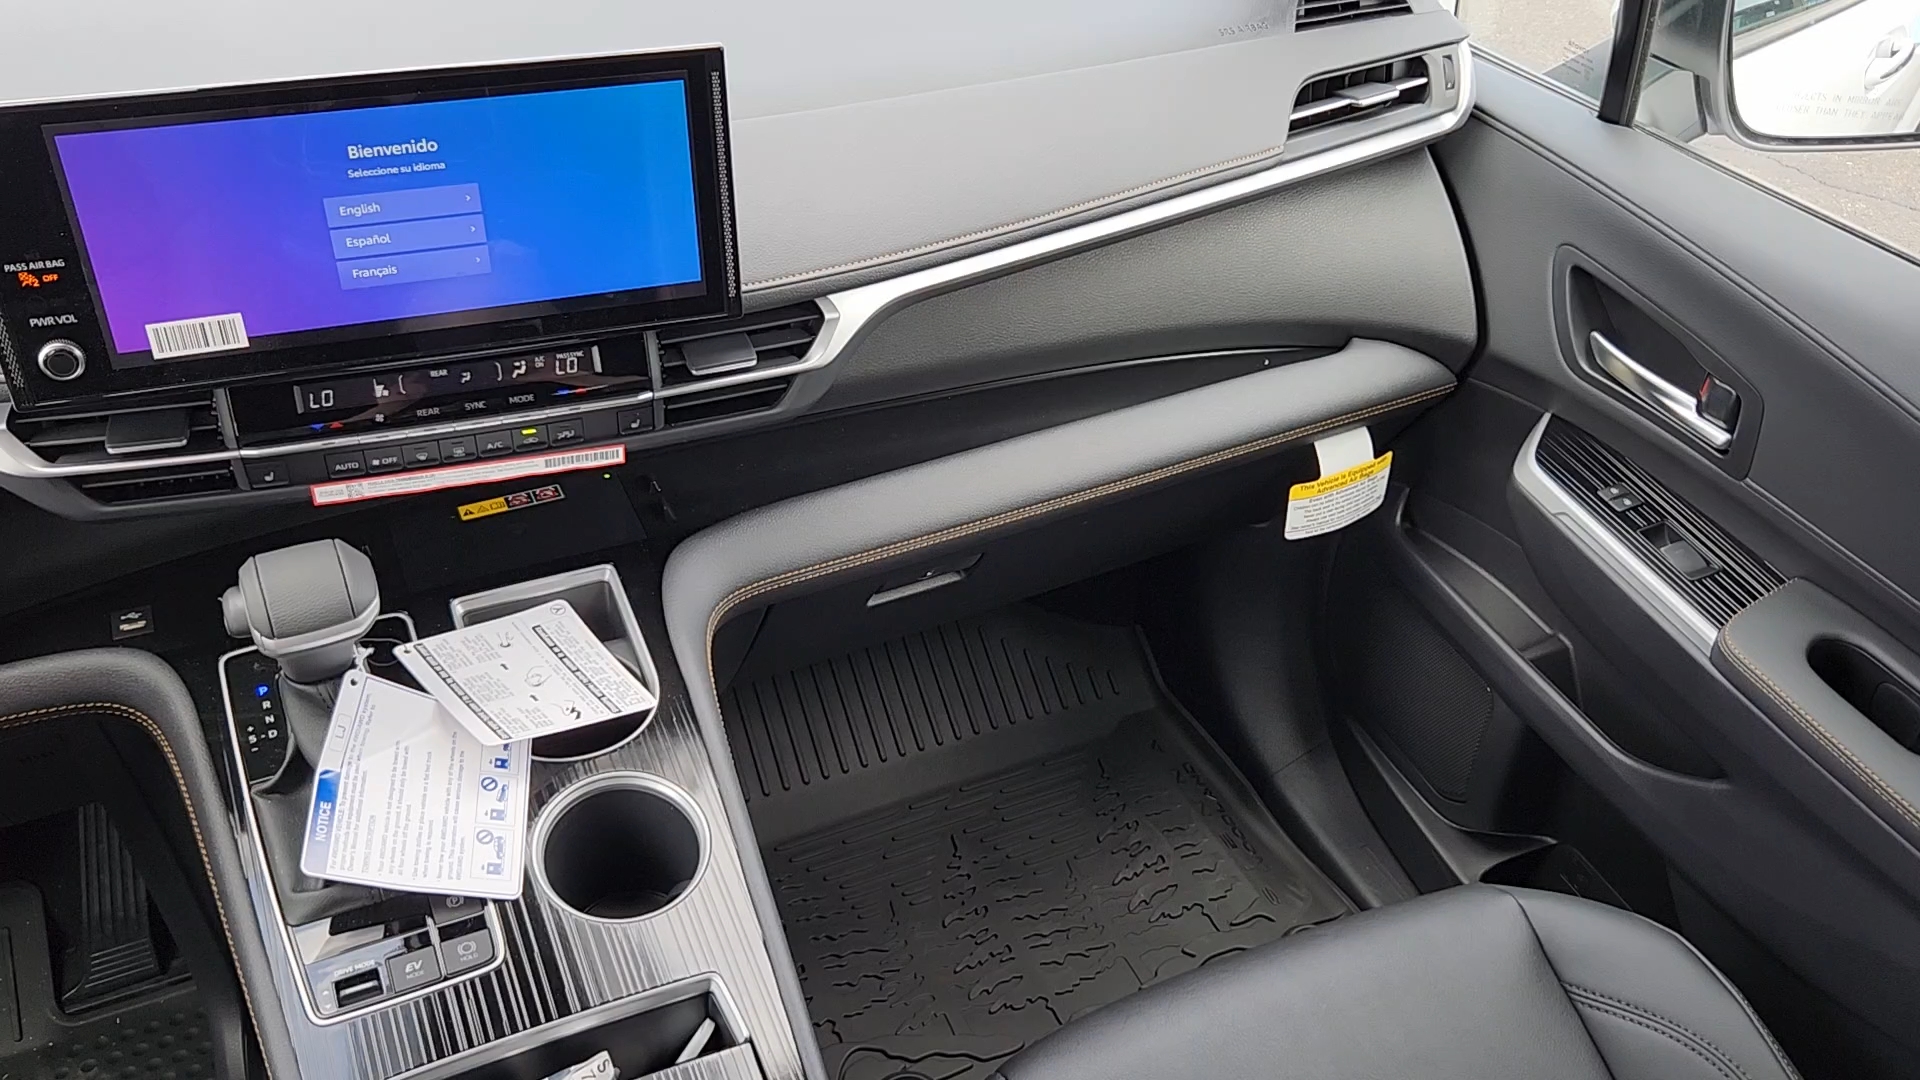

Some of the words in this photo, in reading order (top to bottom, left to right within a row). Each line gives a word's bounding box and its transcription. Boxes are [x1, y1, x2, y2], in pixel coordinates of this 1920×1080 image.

[347, 138, 438, 160] Bienvenido
[347, 165, 399, 179] Seleccione
[400, 164, 412, 174] su
[413, 161, 446, 173] idioma
[339, 202, 381, 218] English
[345, 233, 391, 248] Español
[4, 262, 28, 272] PASS
[29, 260, 45, 270] AIR
[45, 259, 65, 268] BAG
[352, 264, 398, 279] Français
[42, 274, 59, 283] OFF
[29, 315, 56, 328] PWR
[54, 313, 78, 325] VOL
[555, 357, 578, 375] LO
[309, 389, 333, 409] LO
[508, 393, 535, 405] MODE
[464, 400, 487, 411] SYNC
[416, 407, 440, 417] REAR
[486, 441, 504, 450] A/C
[335, 461, 360, 471] AUTO
[381, 456, 398, 465] OFF
[259, 685, 268, 696] P
[262, 700, 272, 710] R
[265, 714, 275, 724] N
[267, 729, 278, 739] D
[314, 800, 332, 841] NOTICE
[460, 952, 479, 962] HOLD
[405, 959, 423, 973] EV
[406, 970, 425, 979] MODE
